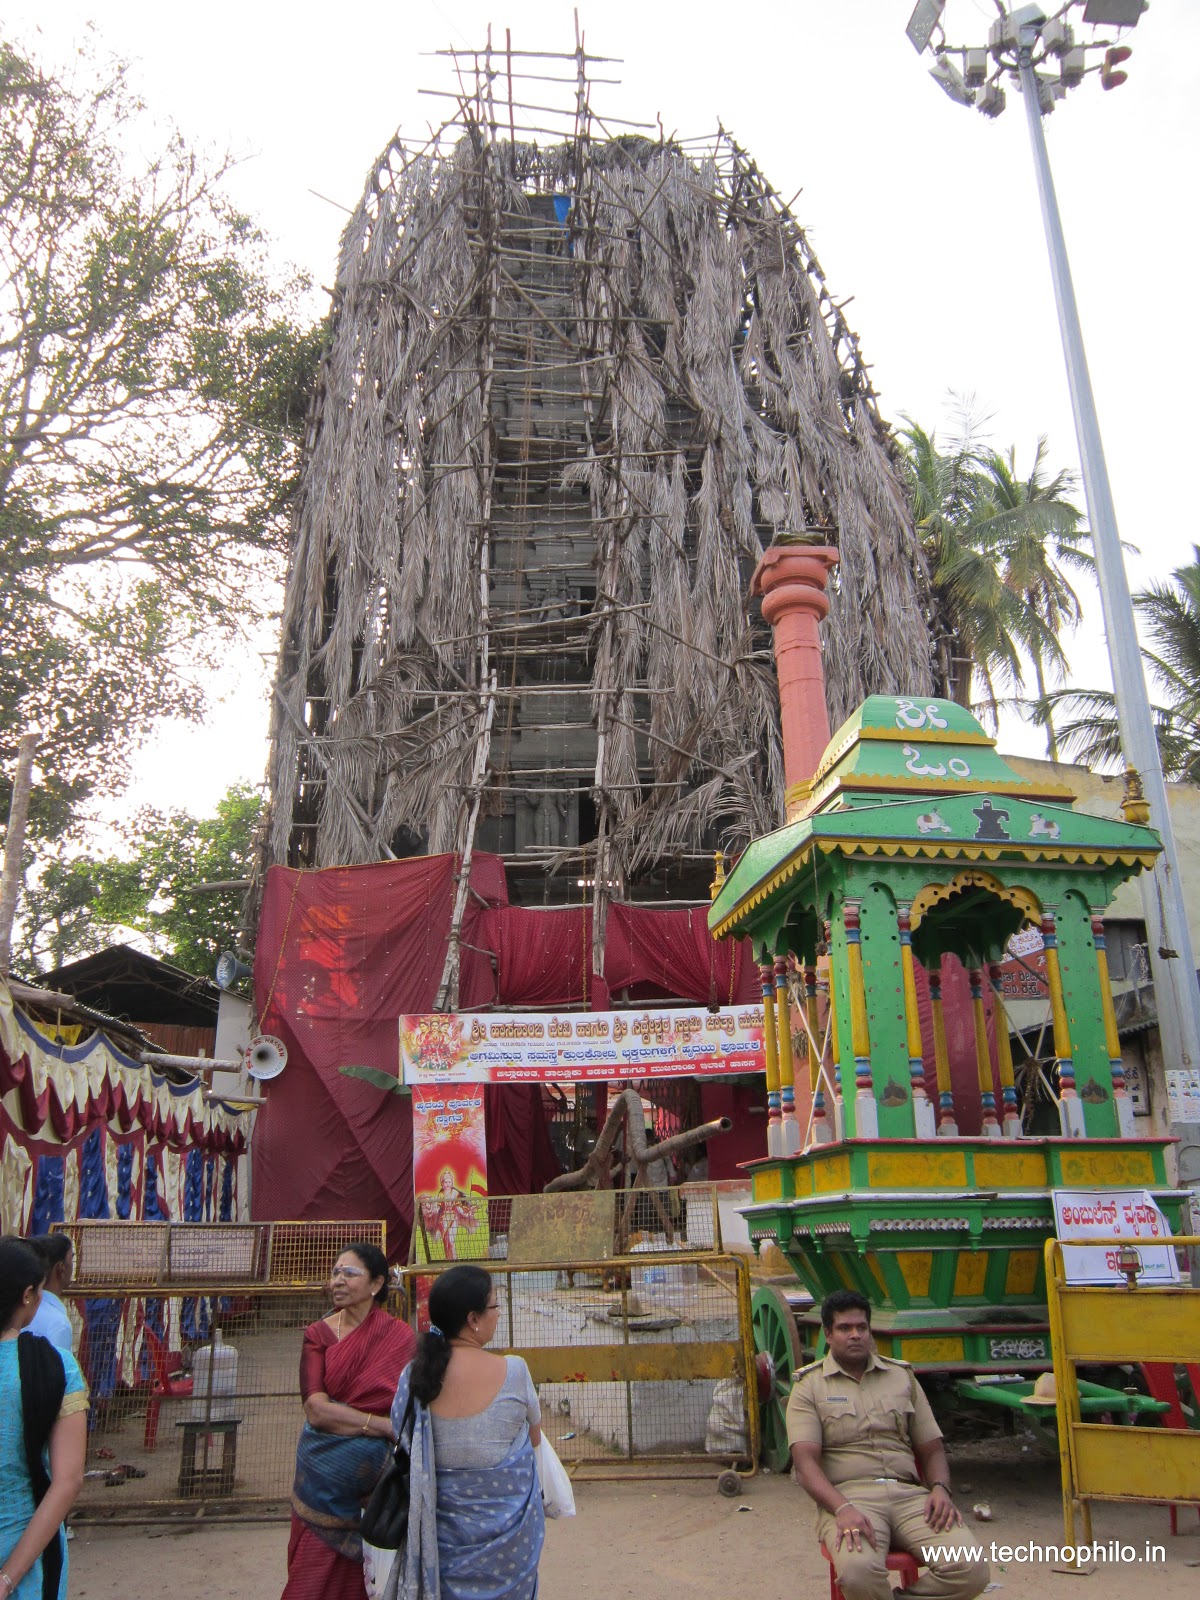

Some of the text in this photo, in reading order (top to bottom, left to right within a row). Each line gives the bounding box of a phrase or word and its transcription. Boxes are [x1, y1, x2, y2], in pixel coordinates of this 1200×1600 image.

[902, 742, 971, 777] ಓಂ
[470, 1018, 487, 1045] ಶ್ರೀ
[490, 1020, 544, 1039] ಹಾಸನಾಂಬ
[548, 1016, 572, 1038] ದೇವಿ
[575, 1018, 609, 1038] ಹಾಗೂ
[612, 1015, 628, 1043] ಶ್ರೀ
[675, 1014, 702, 1043] ಸ್ವಾಮಿ
[706, 1014, 735, 1037] ಜಾತ್ರಾ
[527, 1050, 559, 1065] ಸಮಸ್ತ
[1122, 1201, 1159, 1237] ವ್ಯವಸ್ಥ
